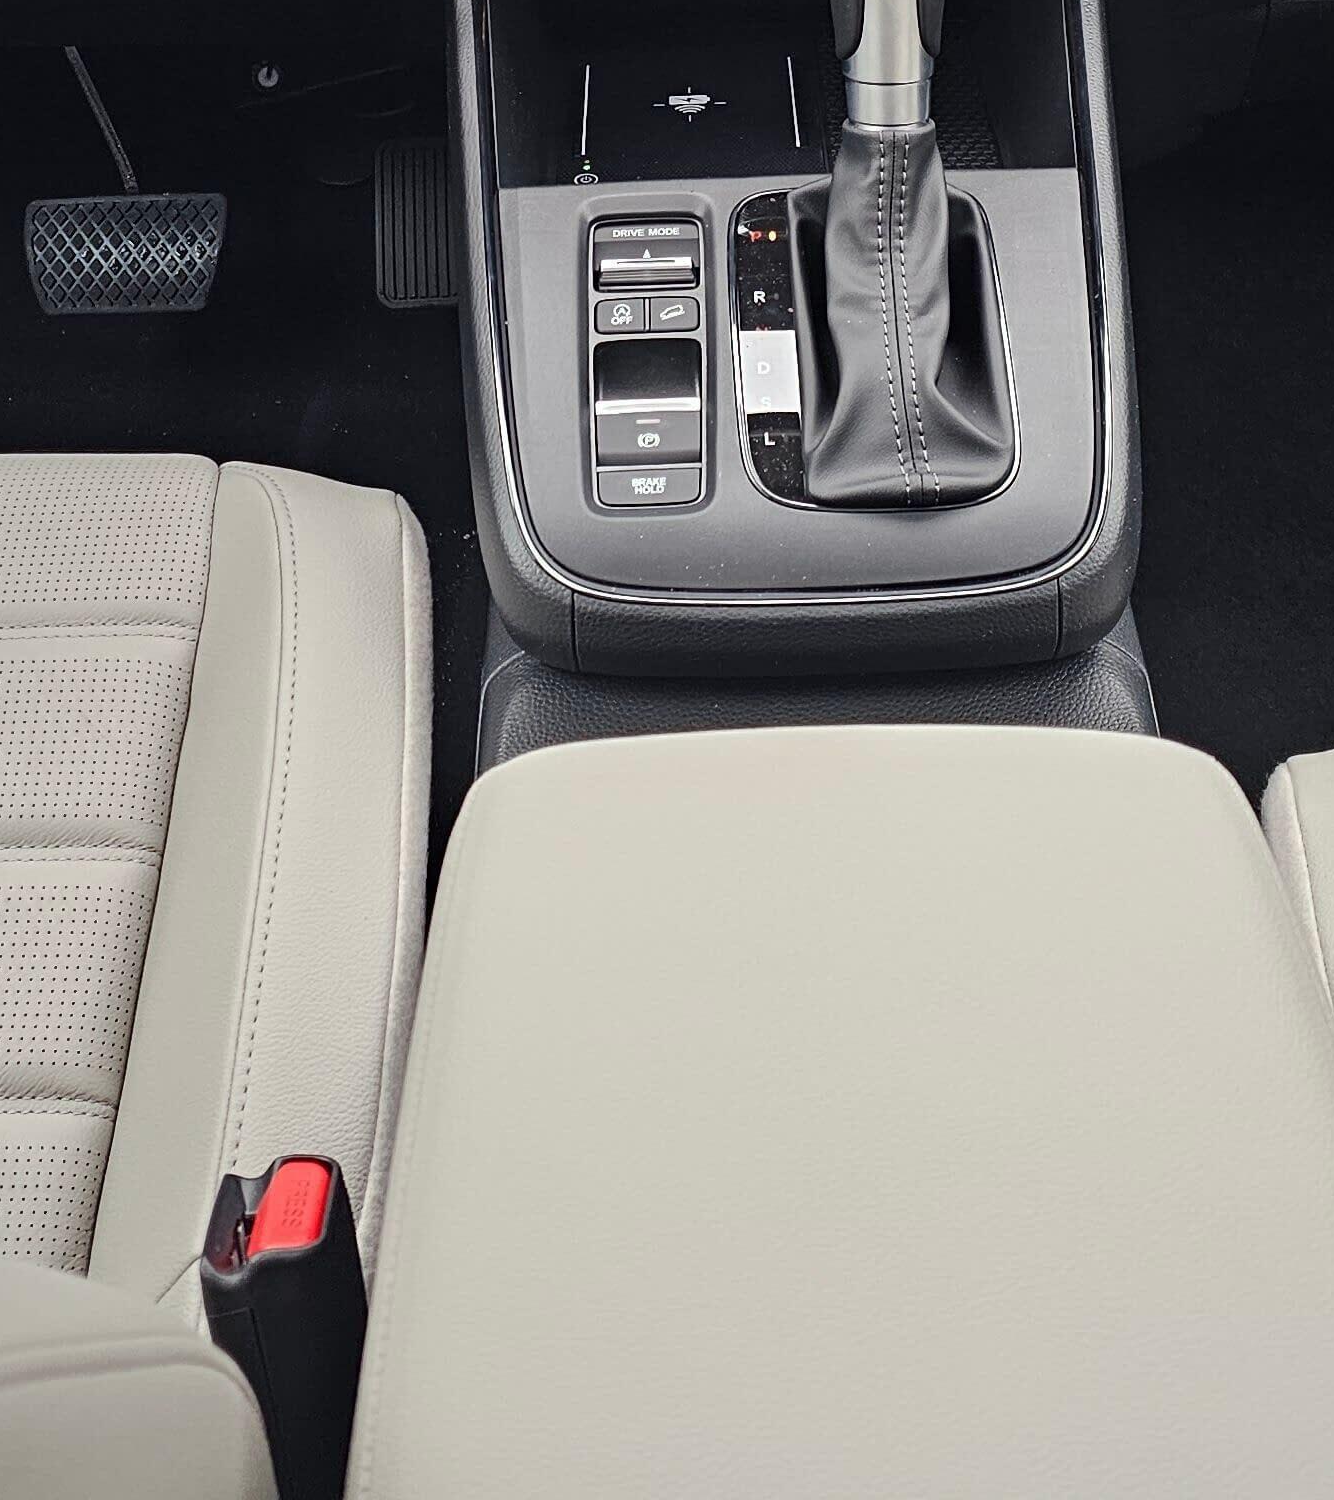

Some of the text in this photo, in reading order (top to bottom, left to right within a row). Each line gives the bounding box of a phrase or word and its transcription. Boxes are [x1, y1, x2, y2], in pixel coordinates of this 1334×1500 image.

[612, 227, 681, 238] DRIVE MODE
[750, 231, 763, 243] P
[753, 290, 766, 304] R
[610, 315, 633, 326] OFF
[757, 361, 771, 375] D
[764, 431, 776, 446] L
[631, 476, 667, 487] BRAKE
[634, 485, 665, 495] HOLD
